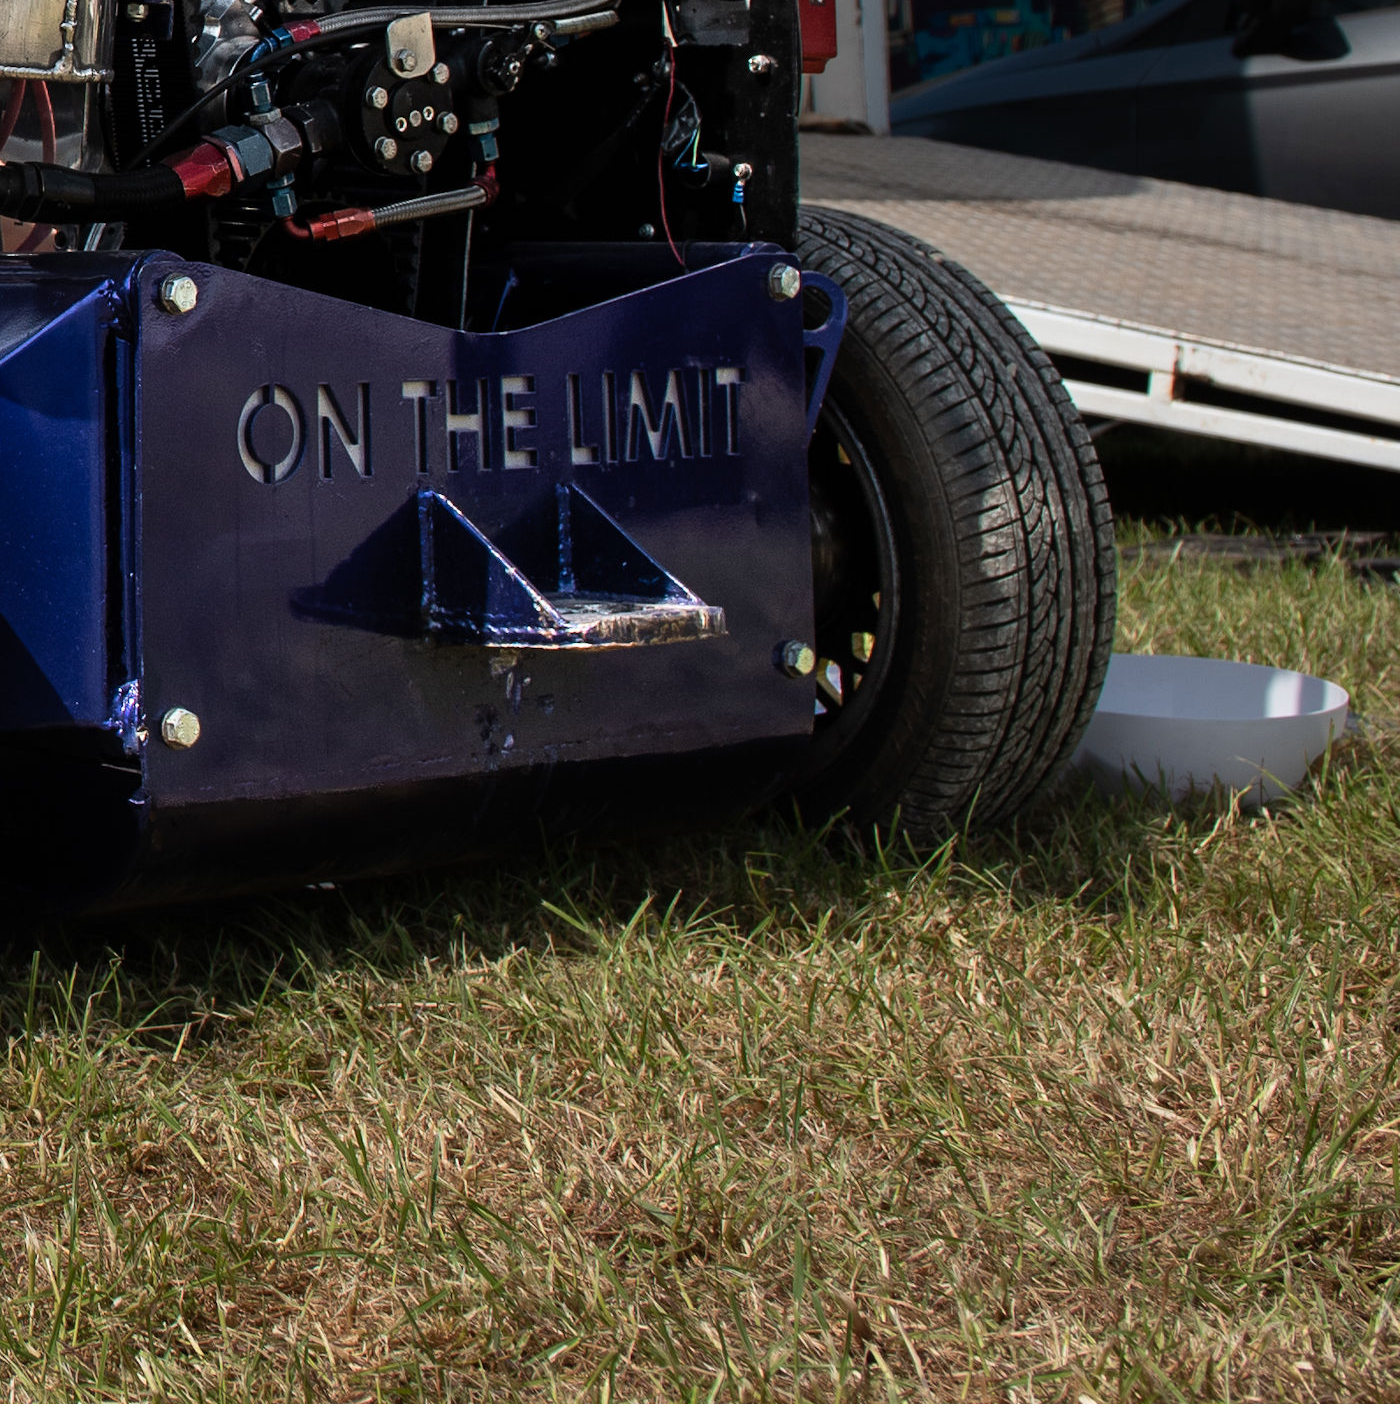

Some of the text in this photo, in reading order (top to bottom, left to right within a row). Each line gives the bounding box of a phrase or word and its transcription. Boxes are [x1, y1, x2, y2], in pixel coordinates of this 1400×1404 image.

[237, 366, 747, 485] ON THE LIMIT
